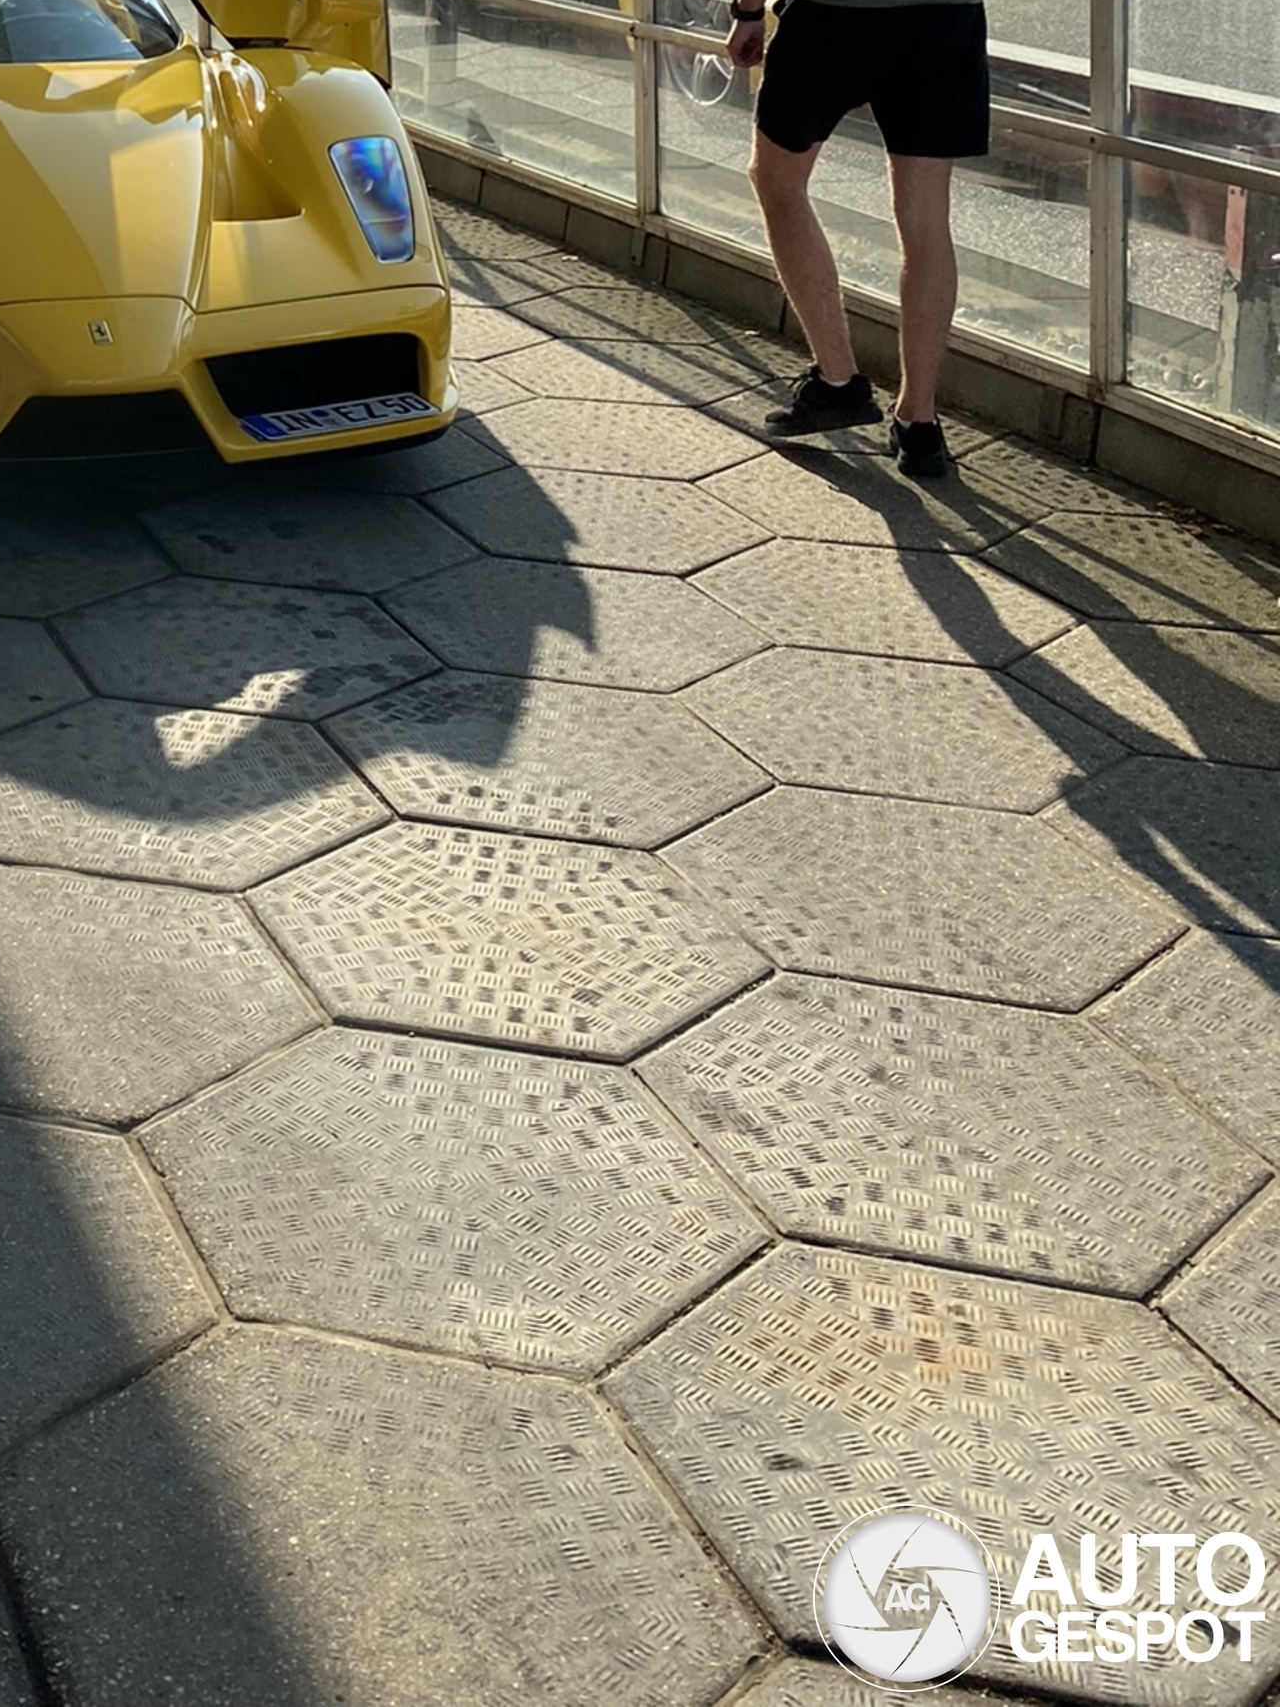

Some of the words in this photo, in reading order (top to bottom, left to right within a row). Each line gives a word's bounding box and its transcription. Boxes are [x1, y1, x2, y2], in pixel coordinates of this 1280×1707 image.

[270, 411, 324, 431] IN
[332, 403, 388, 423] EZ
[381, 395, 431, 415] 50
